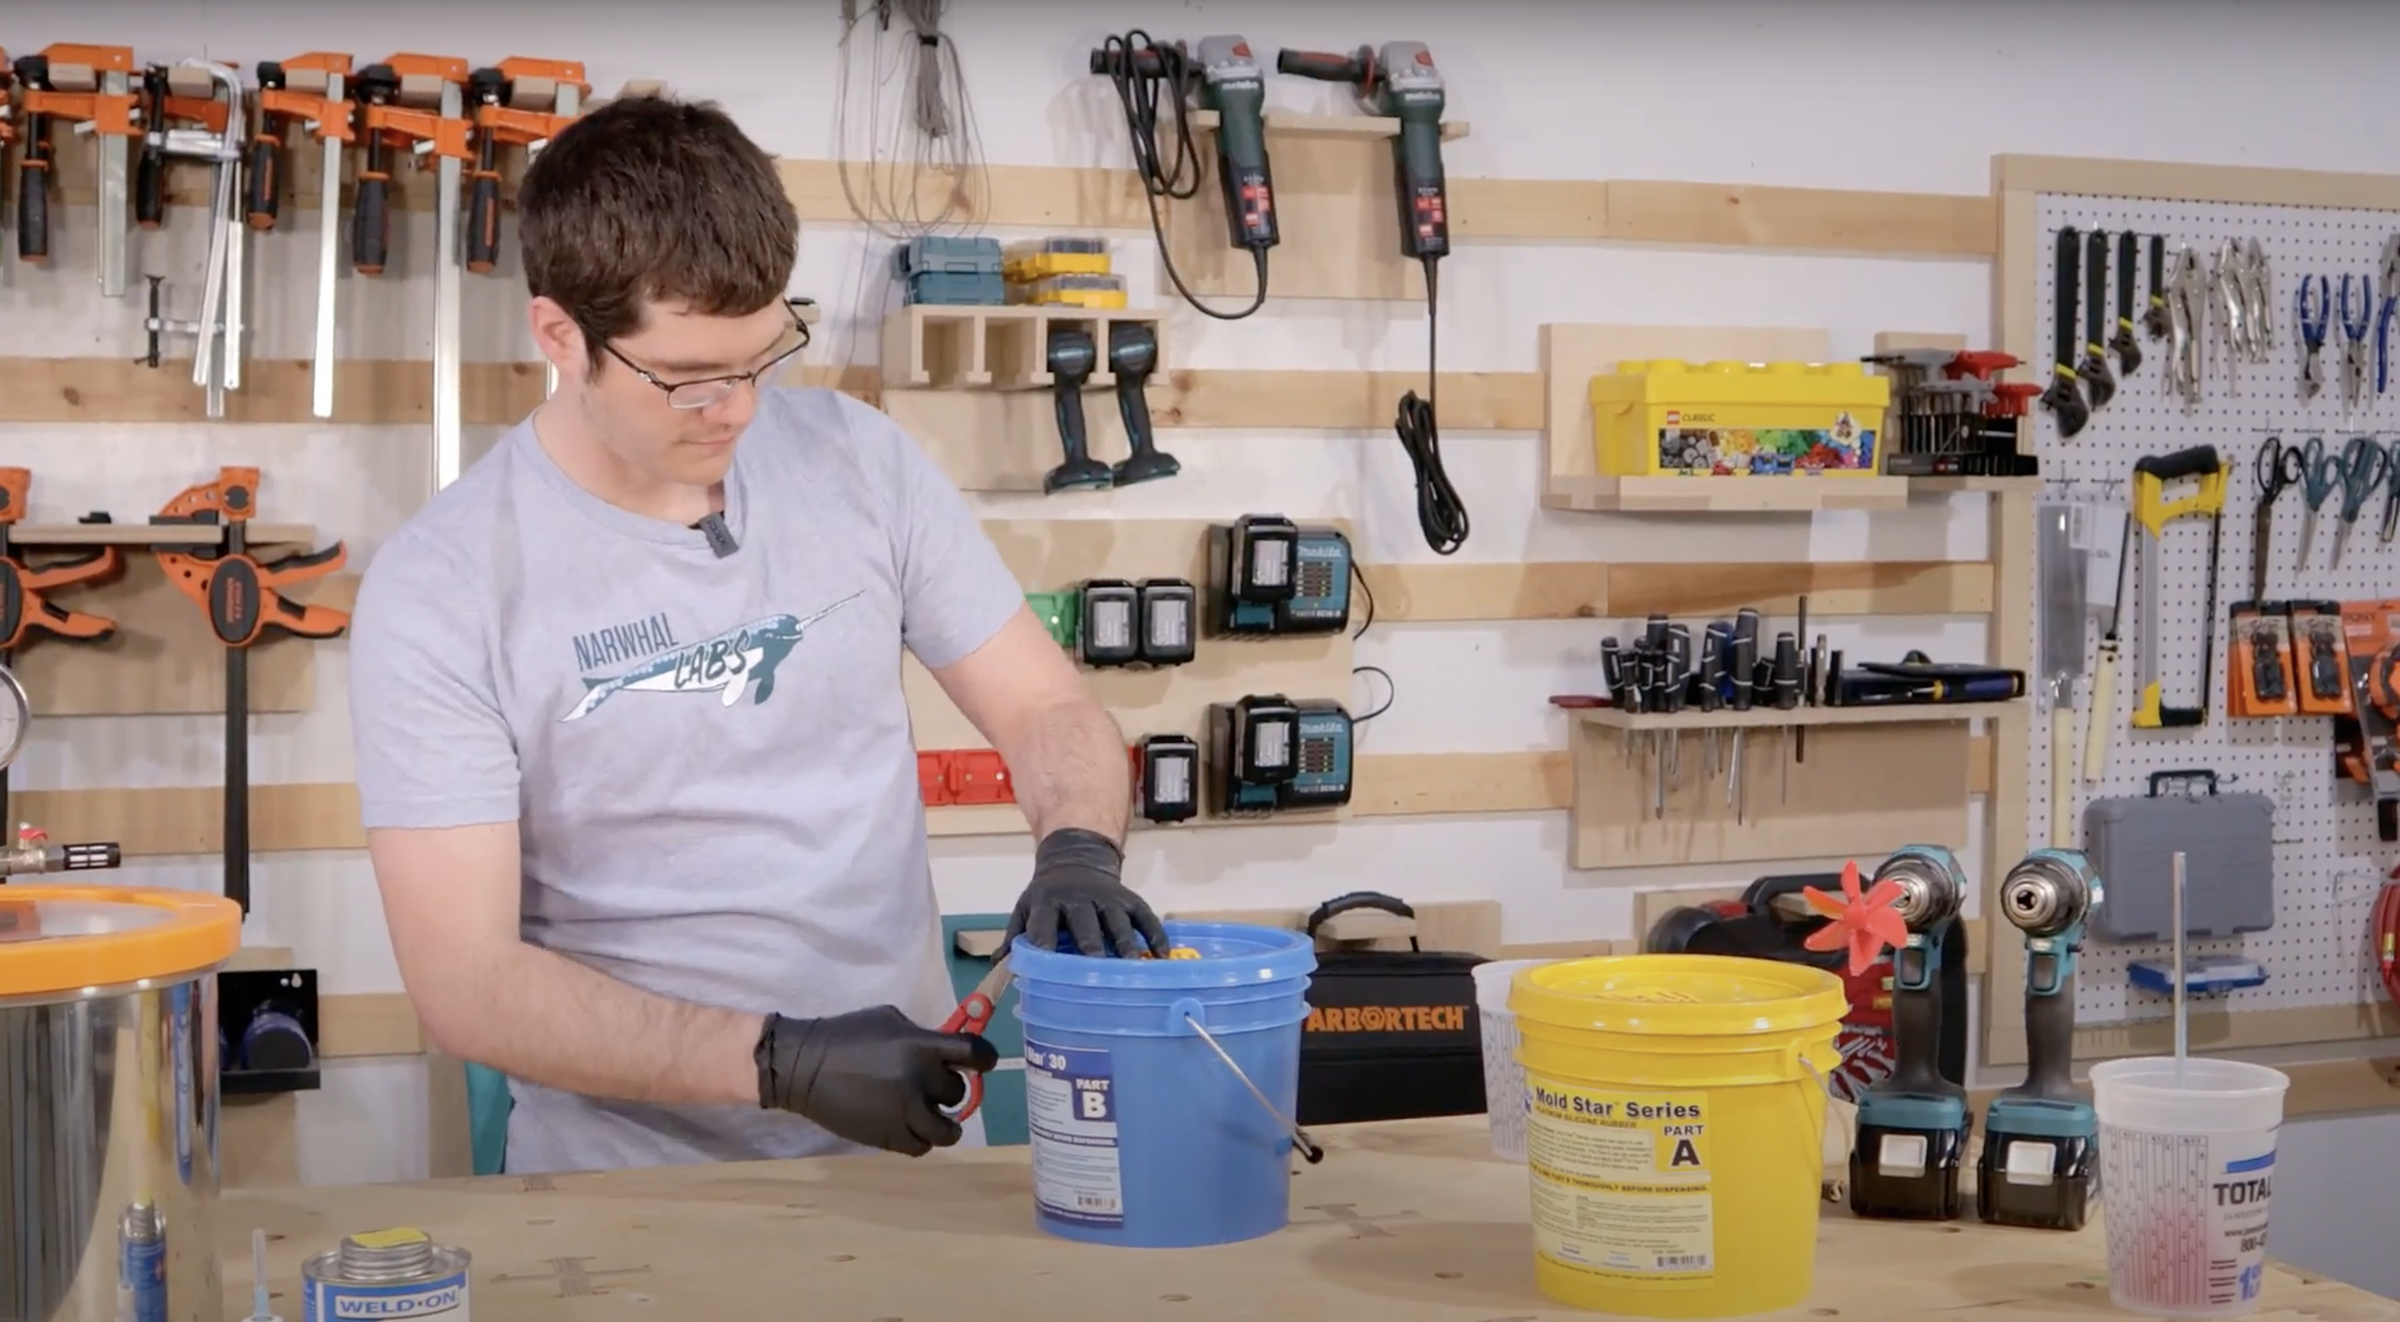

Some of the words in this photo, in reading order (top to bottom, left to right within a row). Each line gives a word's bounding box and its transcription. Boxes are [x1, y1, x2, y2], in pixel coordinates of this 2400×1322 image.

[573, 612, 679, 672] NARWHAL
[673, 629, 752, 689] LABS
[1305, 1005, 1464, 1032] ARBORTECH
[1048, 1053, 1067, 1071] 30
[1076, 1078, 1110, 1090] PART
[1082, 1091, 1107, 1118] B
[1535, 1086, 1567, 1109] Mold
[1573, 1096, 1613, 1116] Star
[1626, 1102, 1701, 1118] Series
[1664, 1125, 1704, 1136] PART
[1671, 1139, 1701, 1167] A
